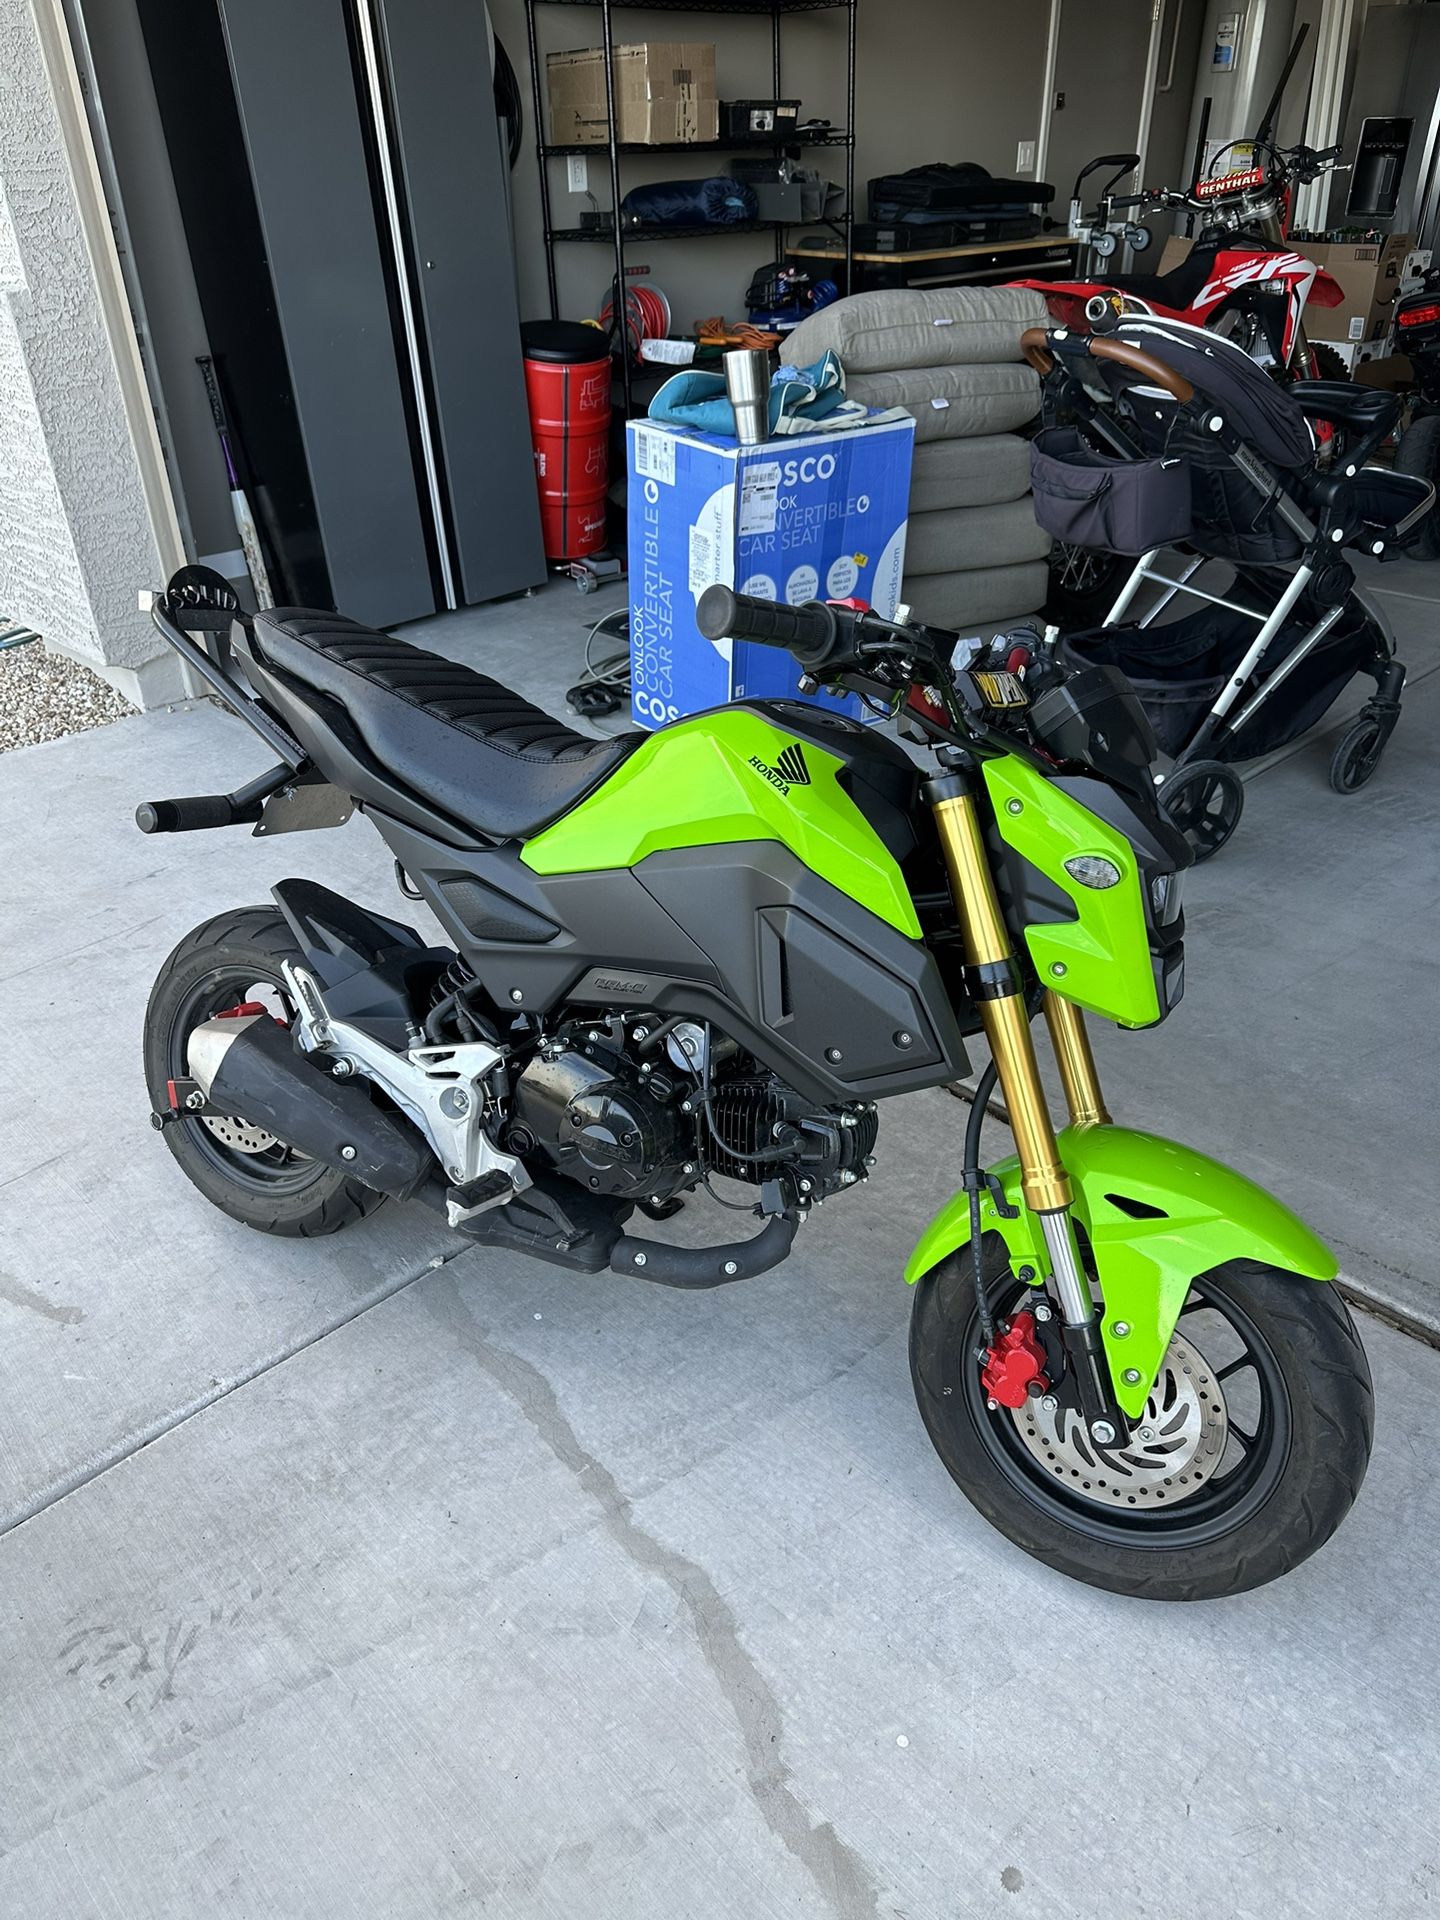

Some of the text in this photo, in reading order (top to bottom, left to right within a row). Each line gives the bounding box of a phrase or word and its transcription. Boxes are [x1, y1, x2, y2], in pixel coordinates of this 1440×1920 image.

[1200, 174, 1259, 196] RENTHAL
[777, 453, 837, 487] SCO
[739, 524, 821, 557] CAR SEAT
[713, 543, 722, 583] marter
[644, 505, 659, 692] CONVERTIBLE
[633, 604, 645, 685] ONLOOK
[659, 570, 674, 699] CAR SEAT
[635, 690, 690, 723] COS
[748, 755, 791, 797] HONDA
